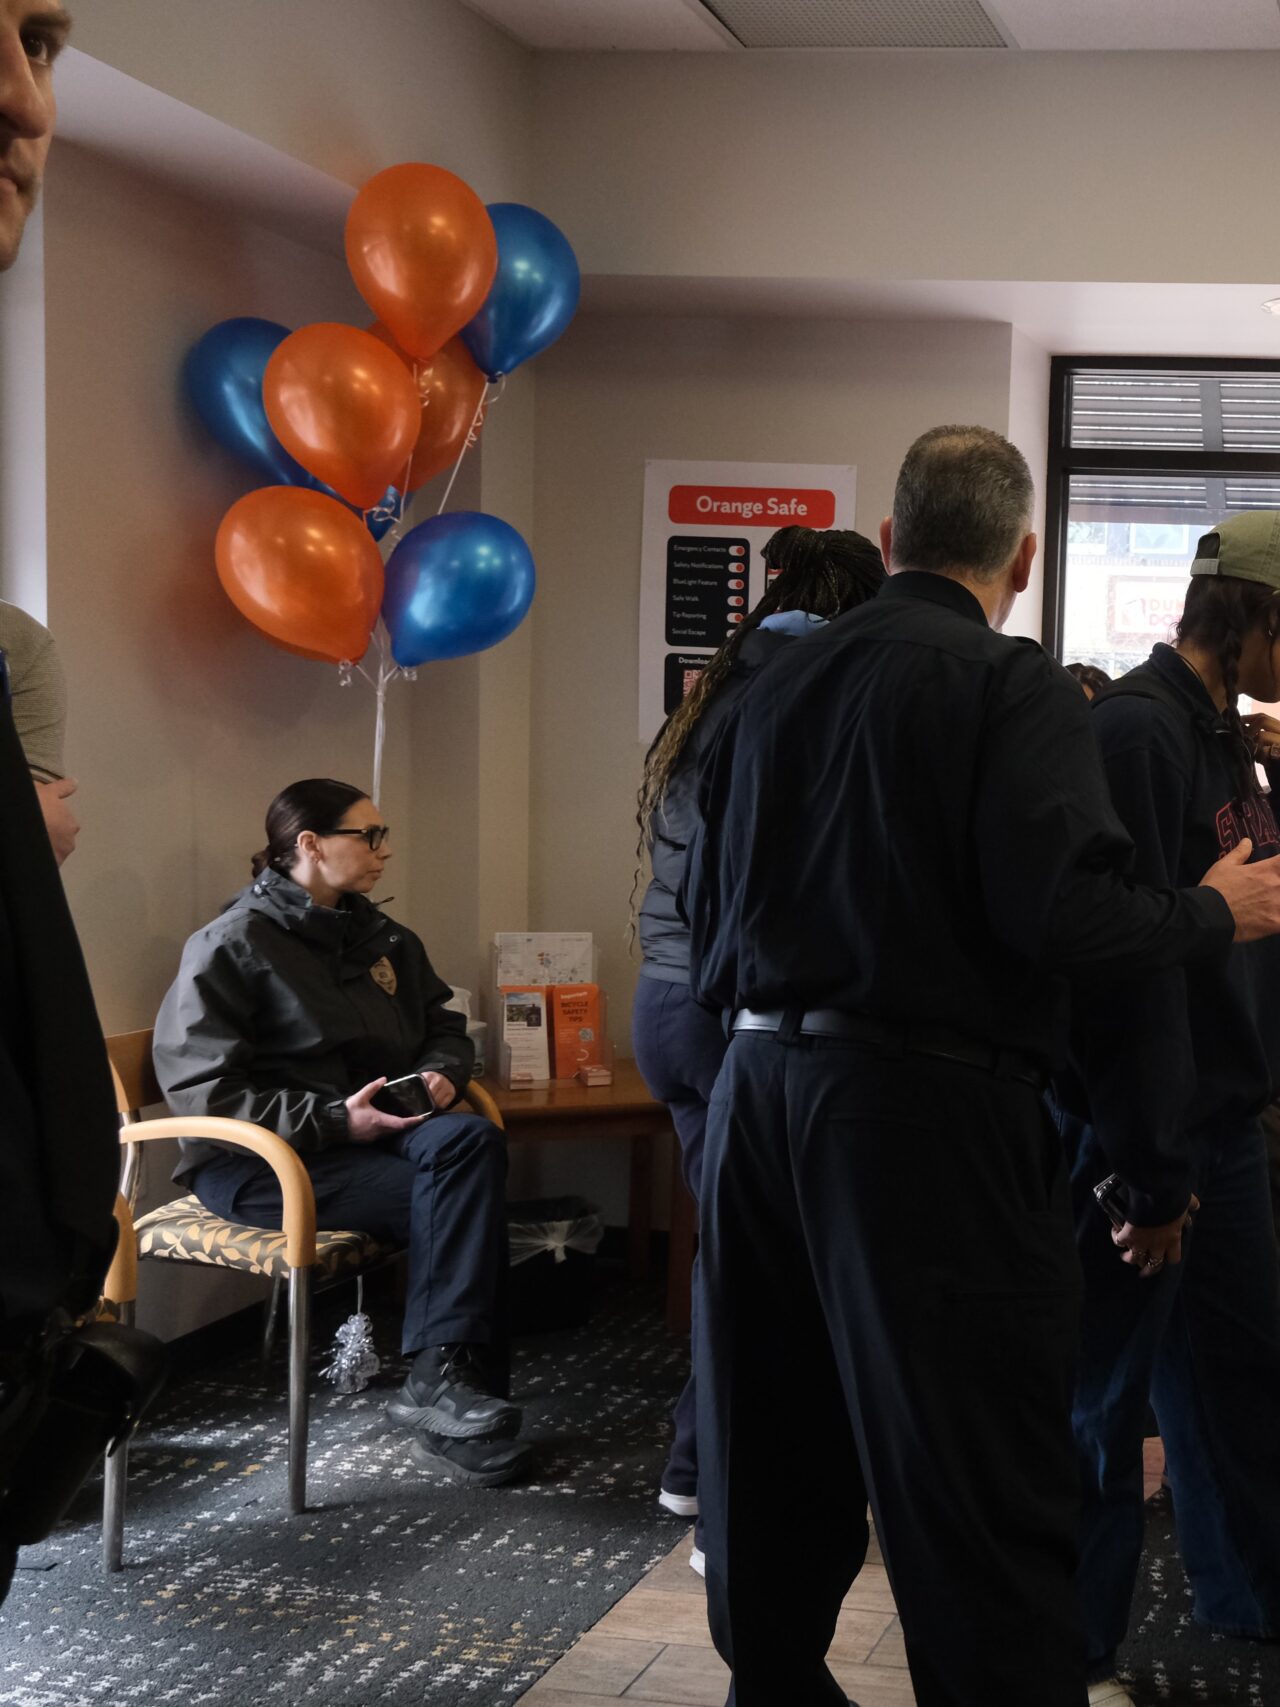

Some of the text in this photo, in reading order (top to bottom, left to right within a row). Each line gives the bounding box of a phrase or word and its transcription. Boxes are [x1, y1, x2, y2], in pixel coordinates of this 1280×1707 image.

[696, 495, 808, 518] Orange Safe
[703, 545, 727, 553] Contacts
